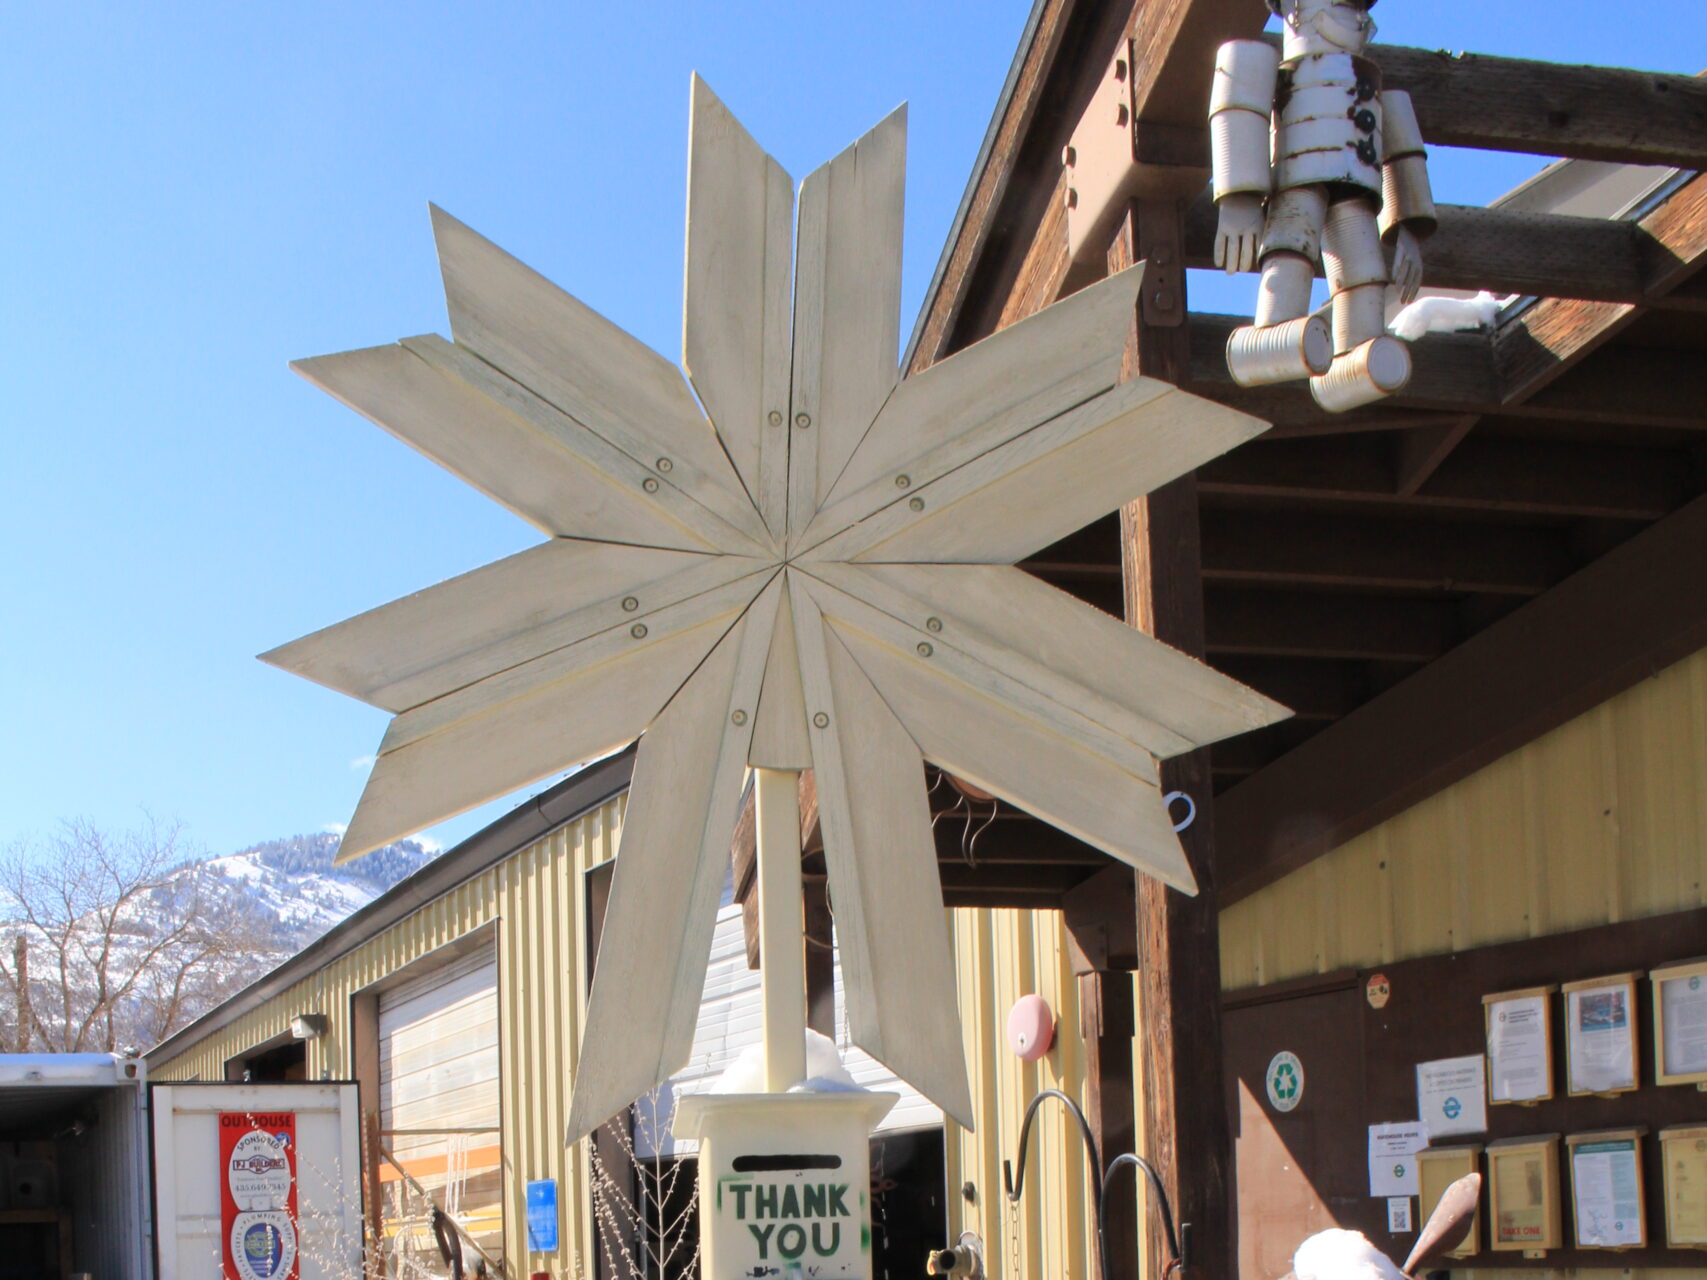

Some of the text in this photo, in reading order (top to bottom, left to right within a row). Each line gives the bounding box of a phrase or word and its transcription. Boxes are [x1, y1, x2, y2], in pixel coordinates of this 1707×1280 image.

[221, 1115, 291, 1128] OUTHOUSE
[237, 1134, 280, 1151] SPONSORED
[728, 1183, 852, 1220] THANK
[242, 1212, 281, 1225] PLUMBING
[1523, 1226, 1540, 1235] ONE
[747, 1223, 842, 1261] YOU
